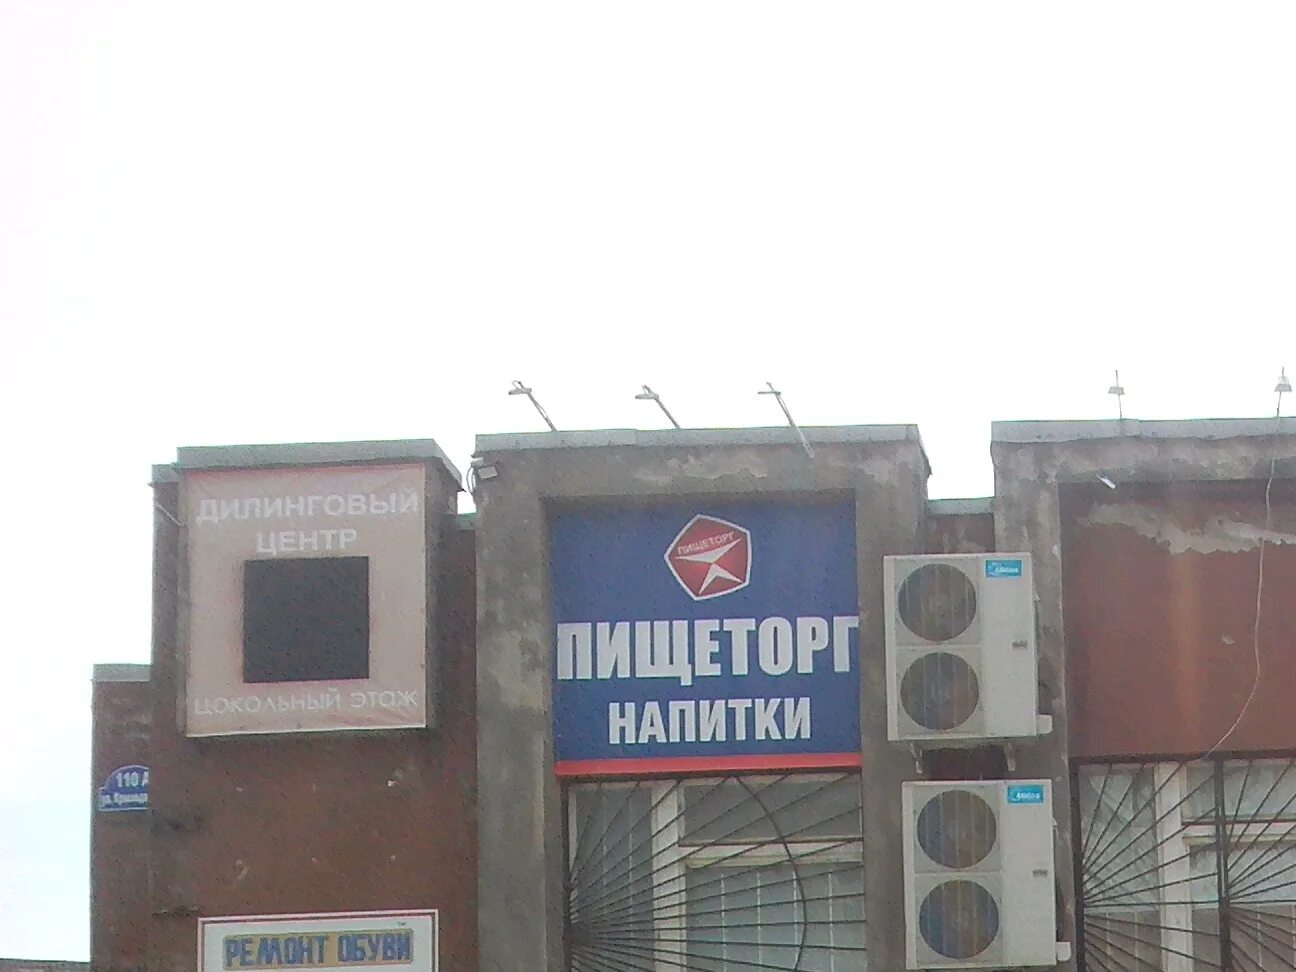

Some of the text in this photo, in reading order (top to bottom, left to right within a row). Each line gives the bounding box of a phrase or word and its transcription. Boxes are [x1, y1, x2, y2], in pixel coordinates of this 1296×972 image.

[196, 488, 418, 525] ДИЛИНГОВЫЙ
[255, 528, 357, 555] ЦЕНТР
[677, 531, 735, 555] ПИЩЕТОРГ
[557, 615, 859, 686] ПИЩЕТОРГ
[194, 687, 341, 715] ЦОКОЛЬНЫЙ
[608, 697, 811, 744] НАПИТКИ
[116, 772, 138, 787] 110
[225, 931, 411, 967] РЕМОНТ ОБУВИ
